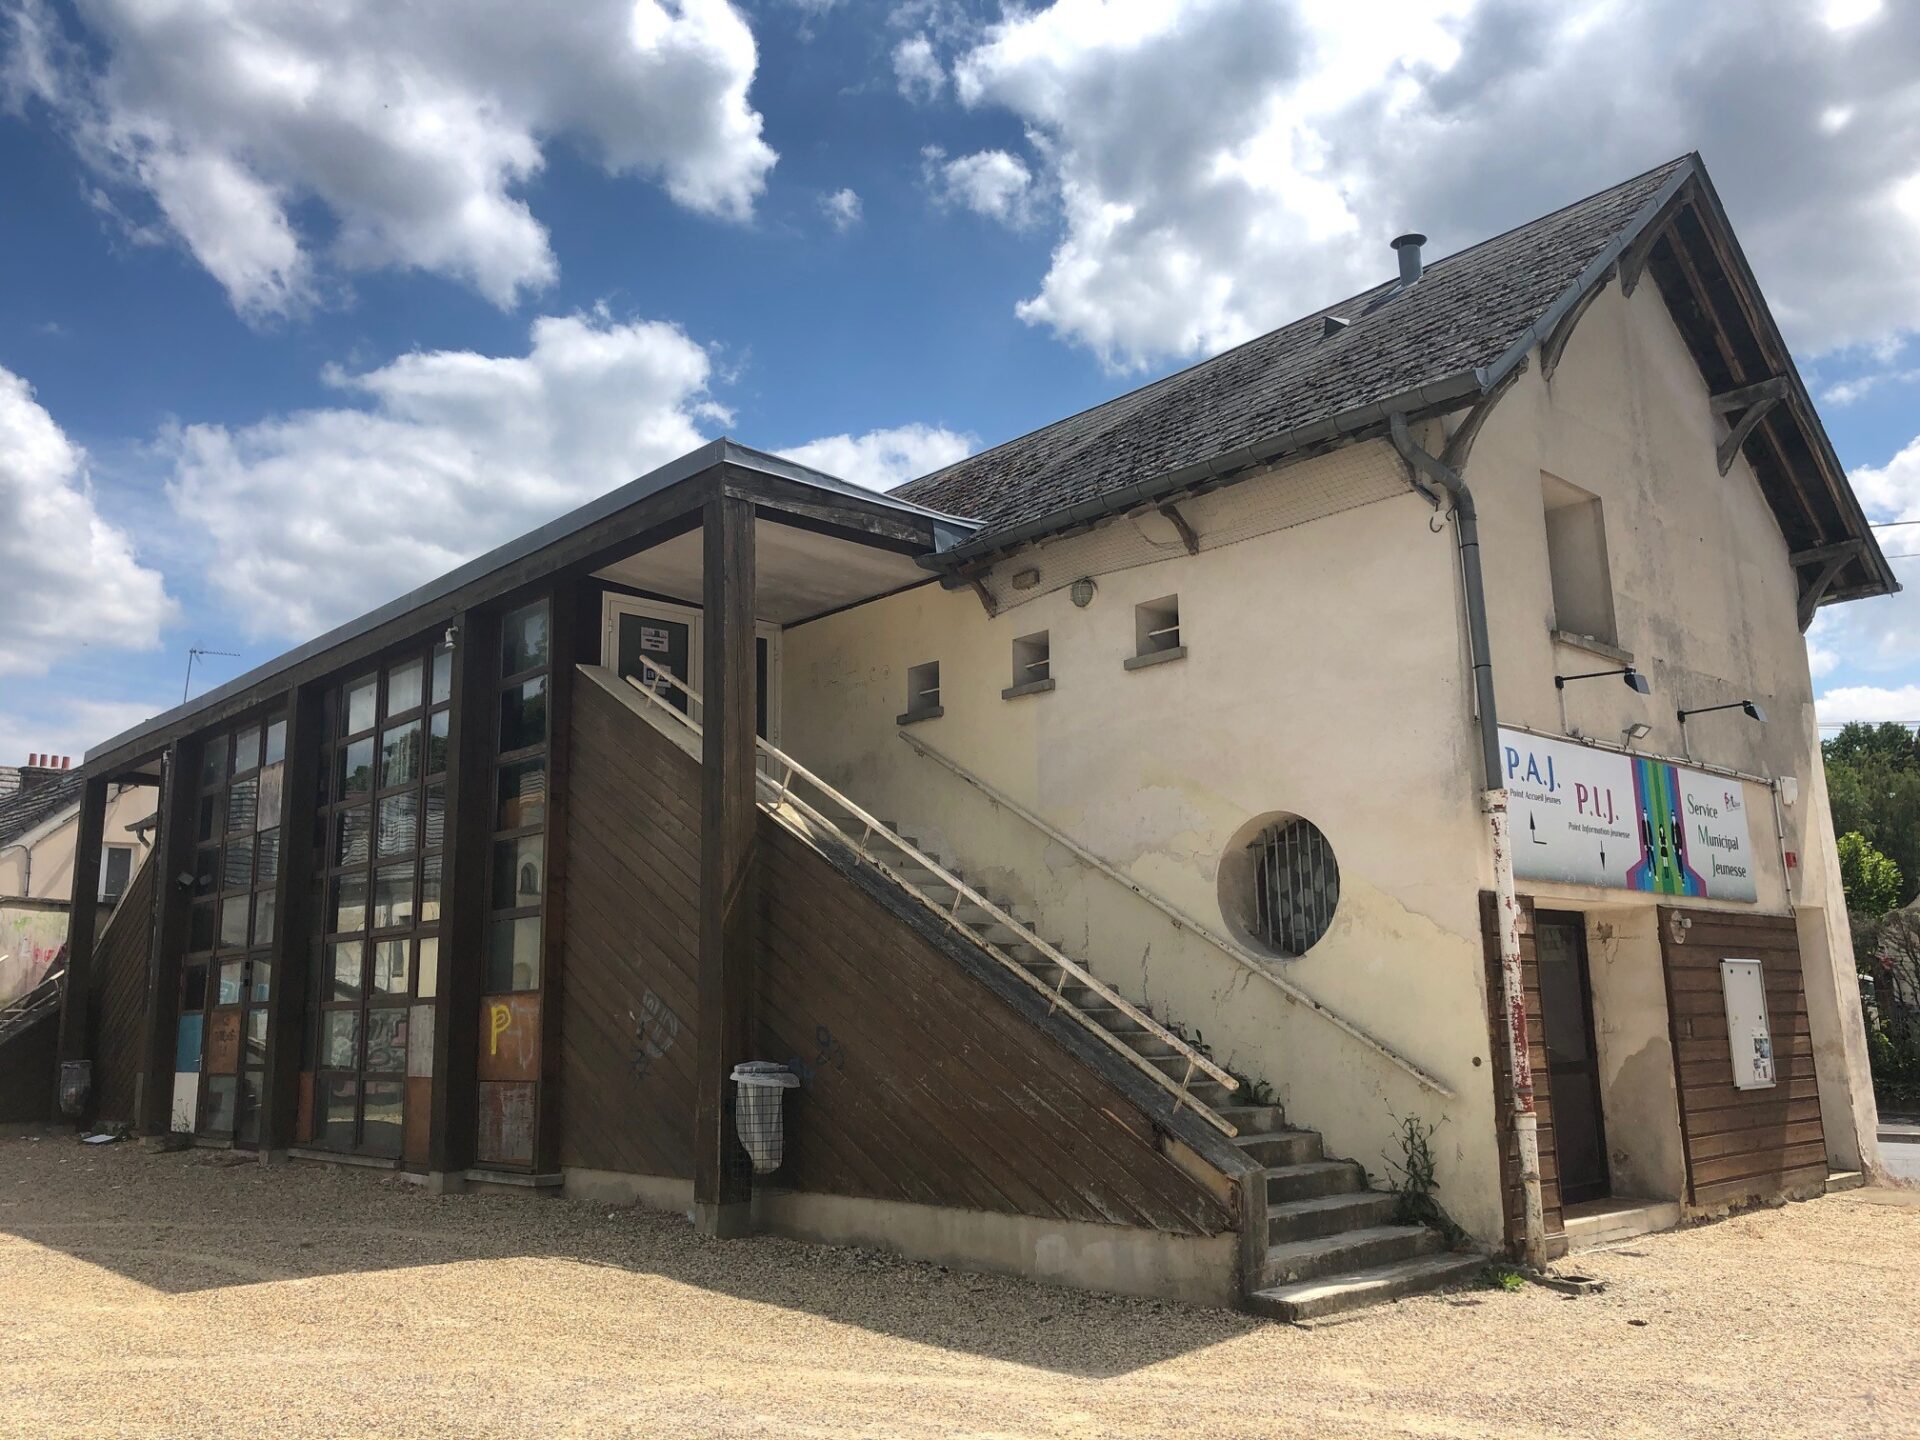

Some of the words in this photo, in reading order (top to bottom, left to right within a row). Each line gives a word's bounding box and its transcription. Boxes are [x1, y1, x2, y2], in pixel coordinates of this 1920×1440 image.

[1504, 746, 1561, 792] P.A.J.
[1509, 788, 1524, 799] Point
[1525, 791, 1544, 802] Accueil
[1686, 793, 1719, 819] Service
[1568, 821, 1581, 832] Point
[1581, 824, 1610, 836] Information
[1697, 824, 1740, 853] Municipal
[1711, 853, 1747, 879] Jeunesse
